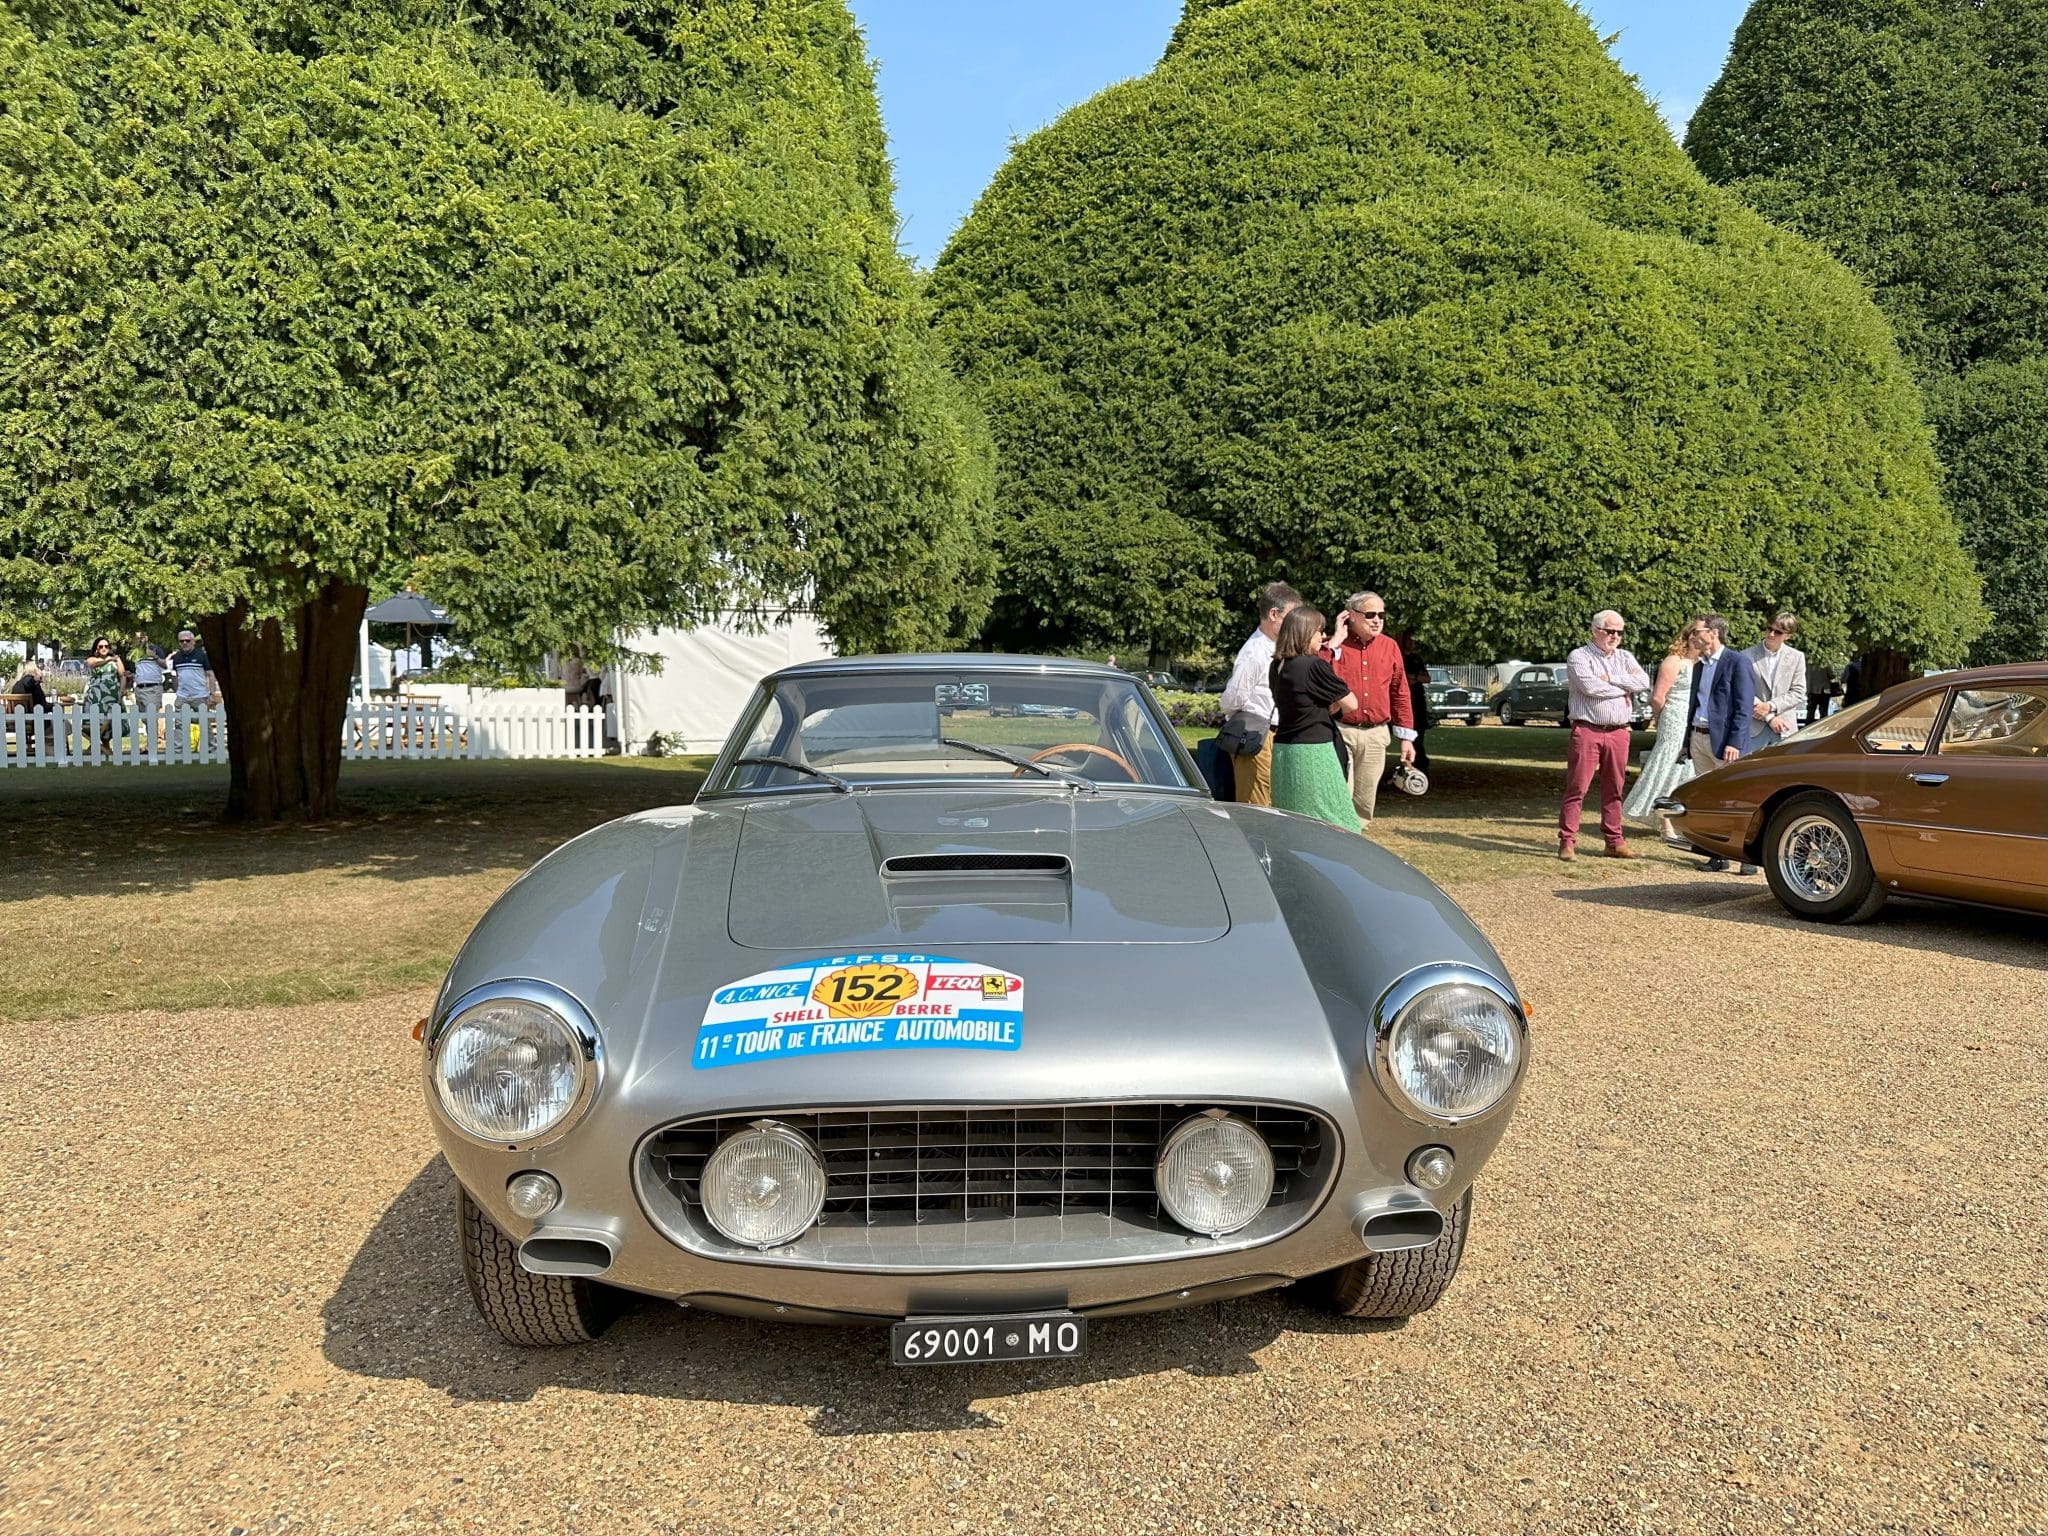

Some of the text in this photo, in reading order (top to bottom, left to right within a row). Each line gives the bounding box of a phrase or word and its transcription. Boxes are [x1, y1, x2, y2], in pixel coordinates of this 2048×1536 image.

[832, 974, 903, 1002] 152
[932, 976, 1018, 990] L'EQUE
[772, 1004, 953, 1024] SHELL BERRE
[735, 1028, 784, 1056] TOUR
[787, 1031, 806, 1049] DE
[810, 1021, 886, 1047] FRANCE
[895, 1019, 1016, 1043] AUTOMOBILE
[904, 1322, 1078, 1359] 69001 MO
